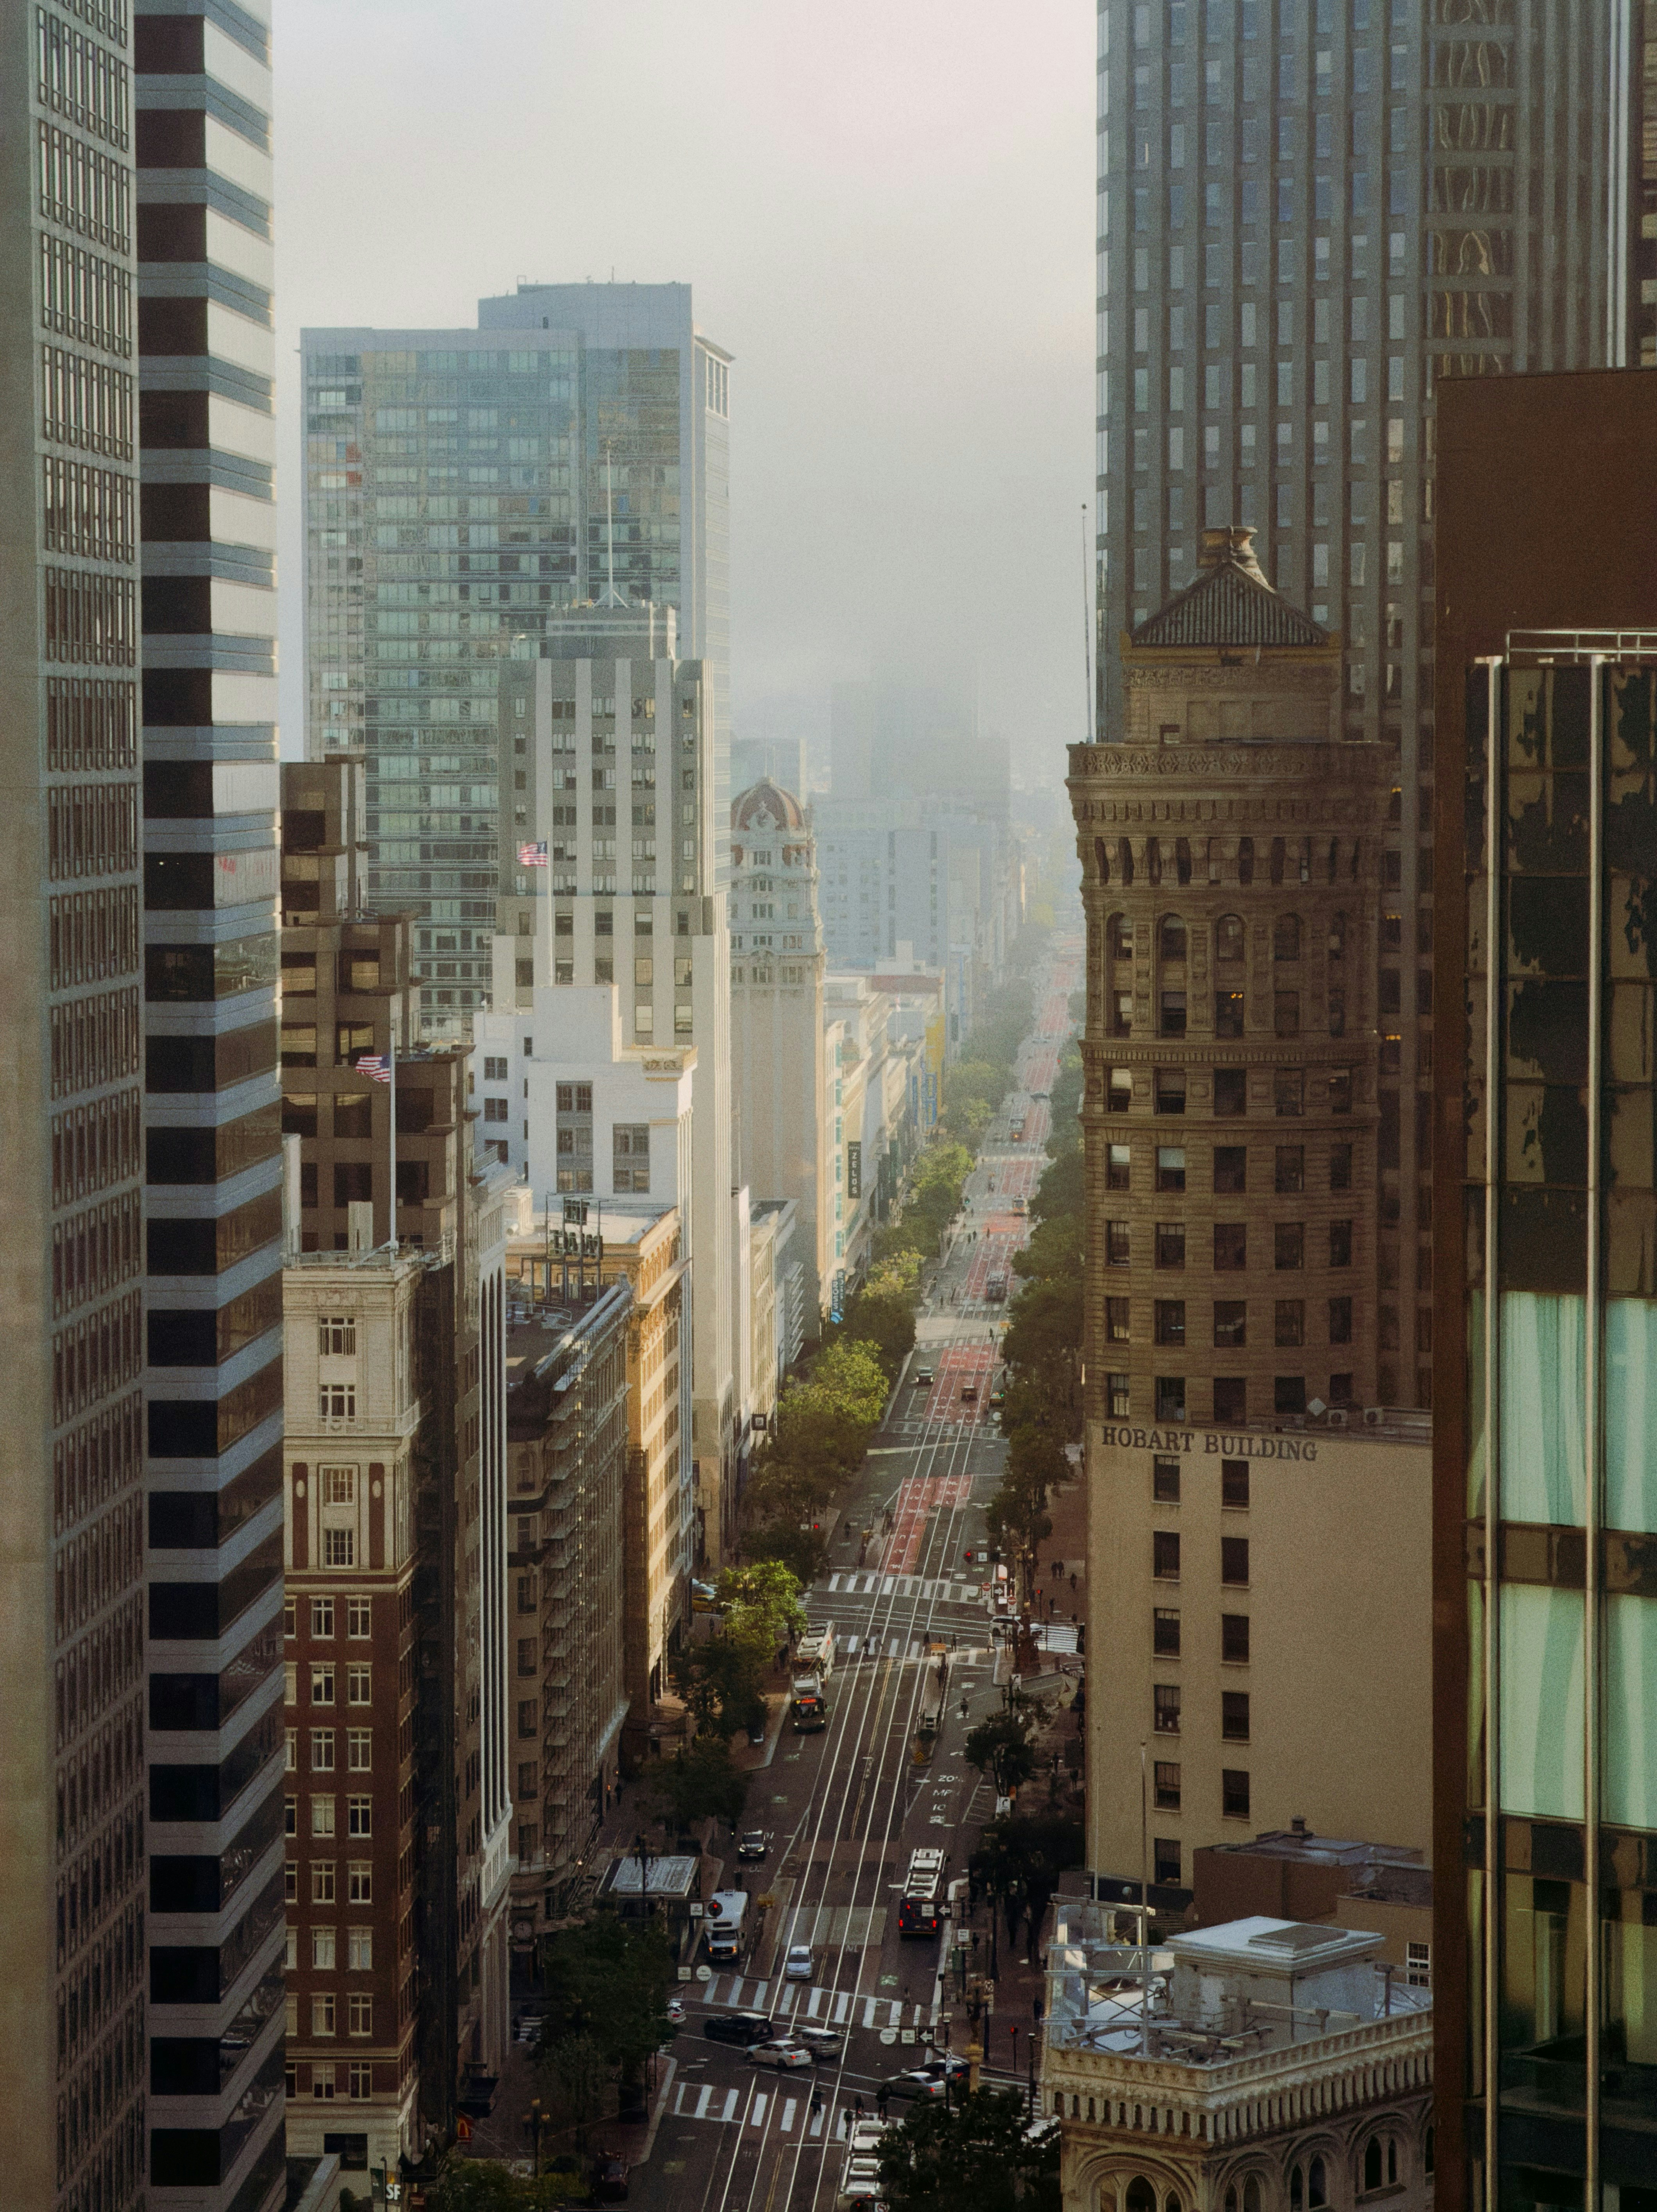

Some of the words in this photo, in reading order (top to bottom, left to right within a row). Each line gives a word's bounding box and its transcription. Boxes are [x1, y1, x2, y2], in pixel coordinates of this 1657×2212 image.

[1102, 1426, 1194, 1452] HOBART
[1204, 1434, 1318, 1461] BUILDING
[386, 2183, 401, 2200] SF
